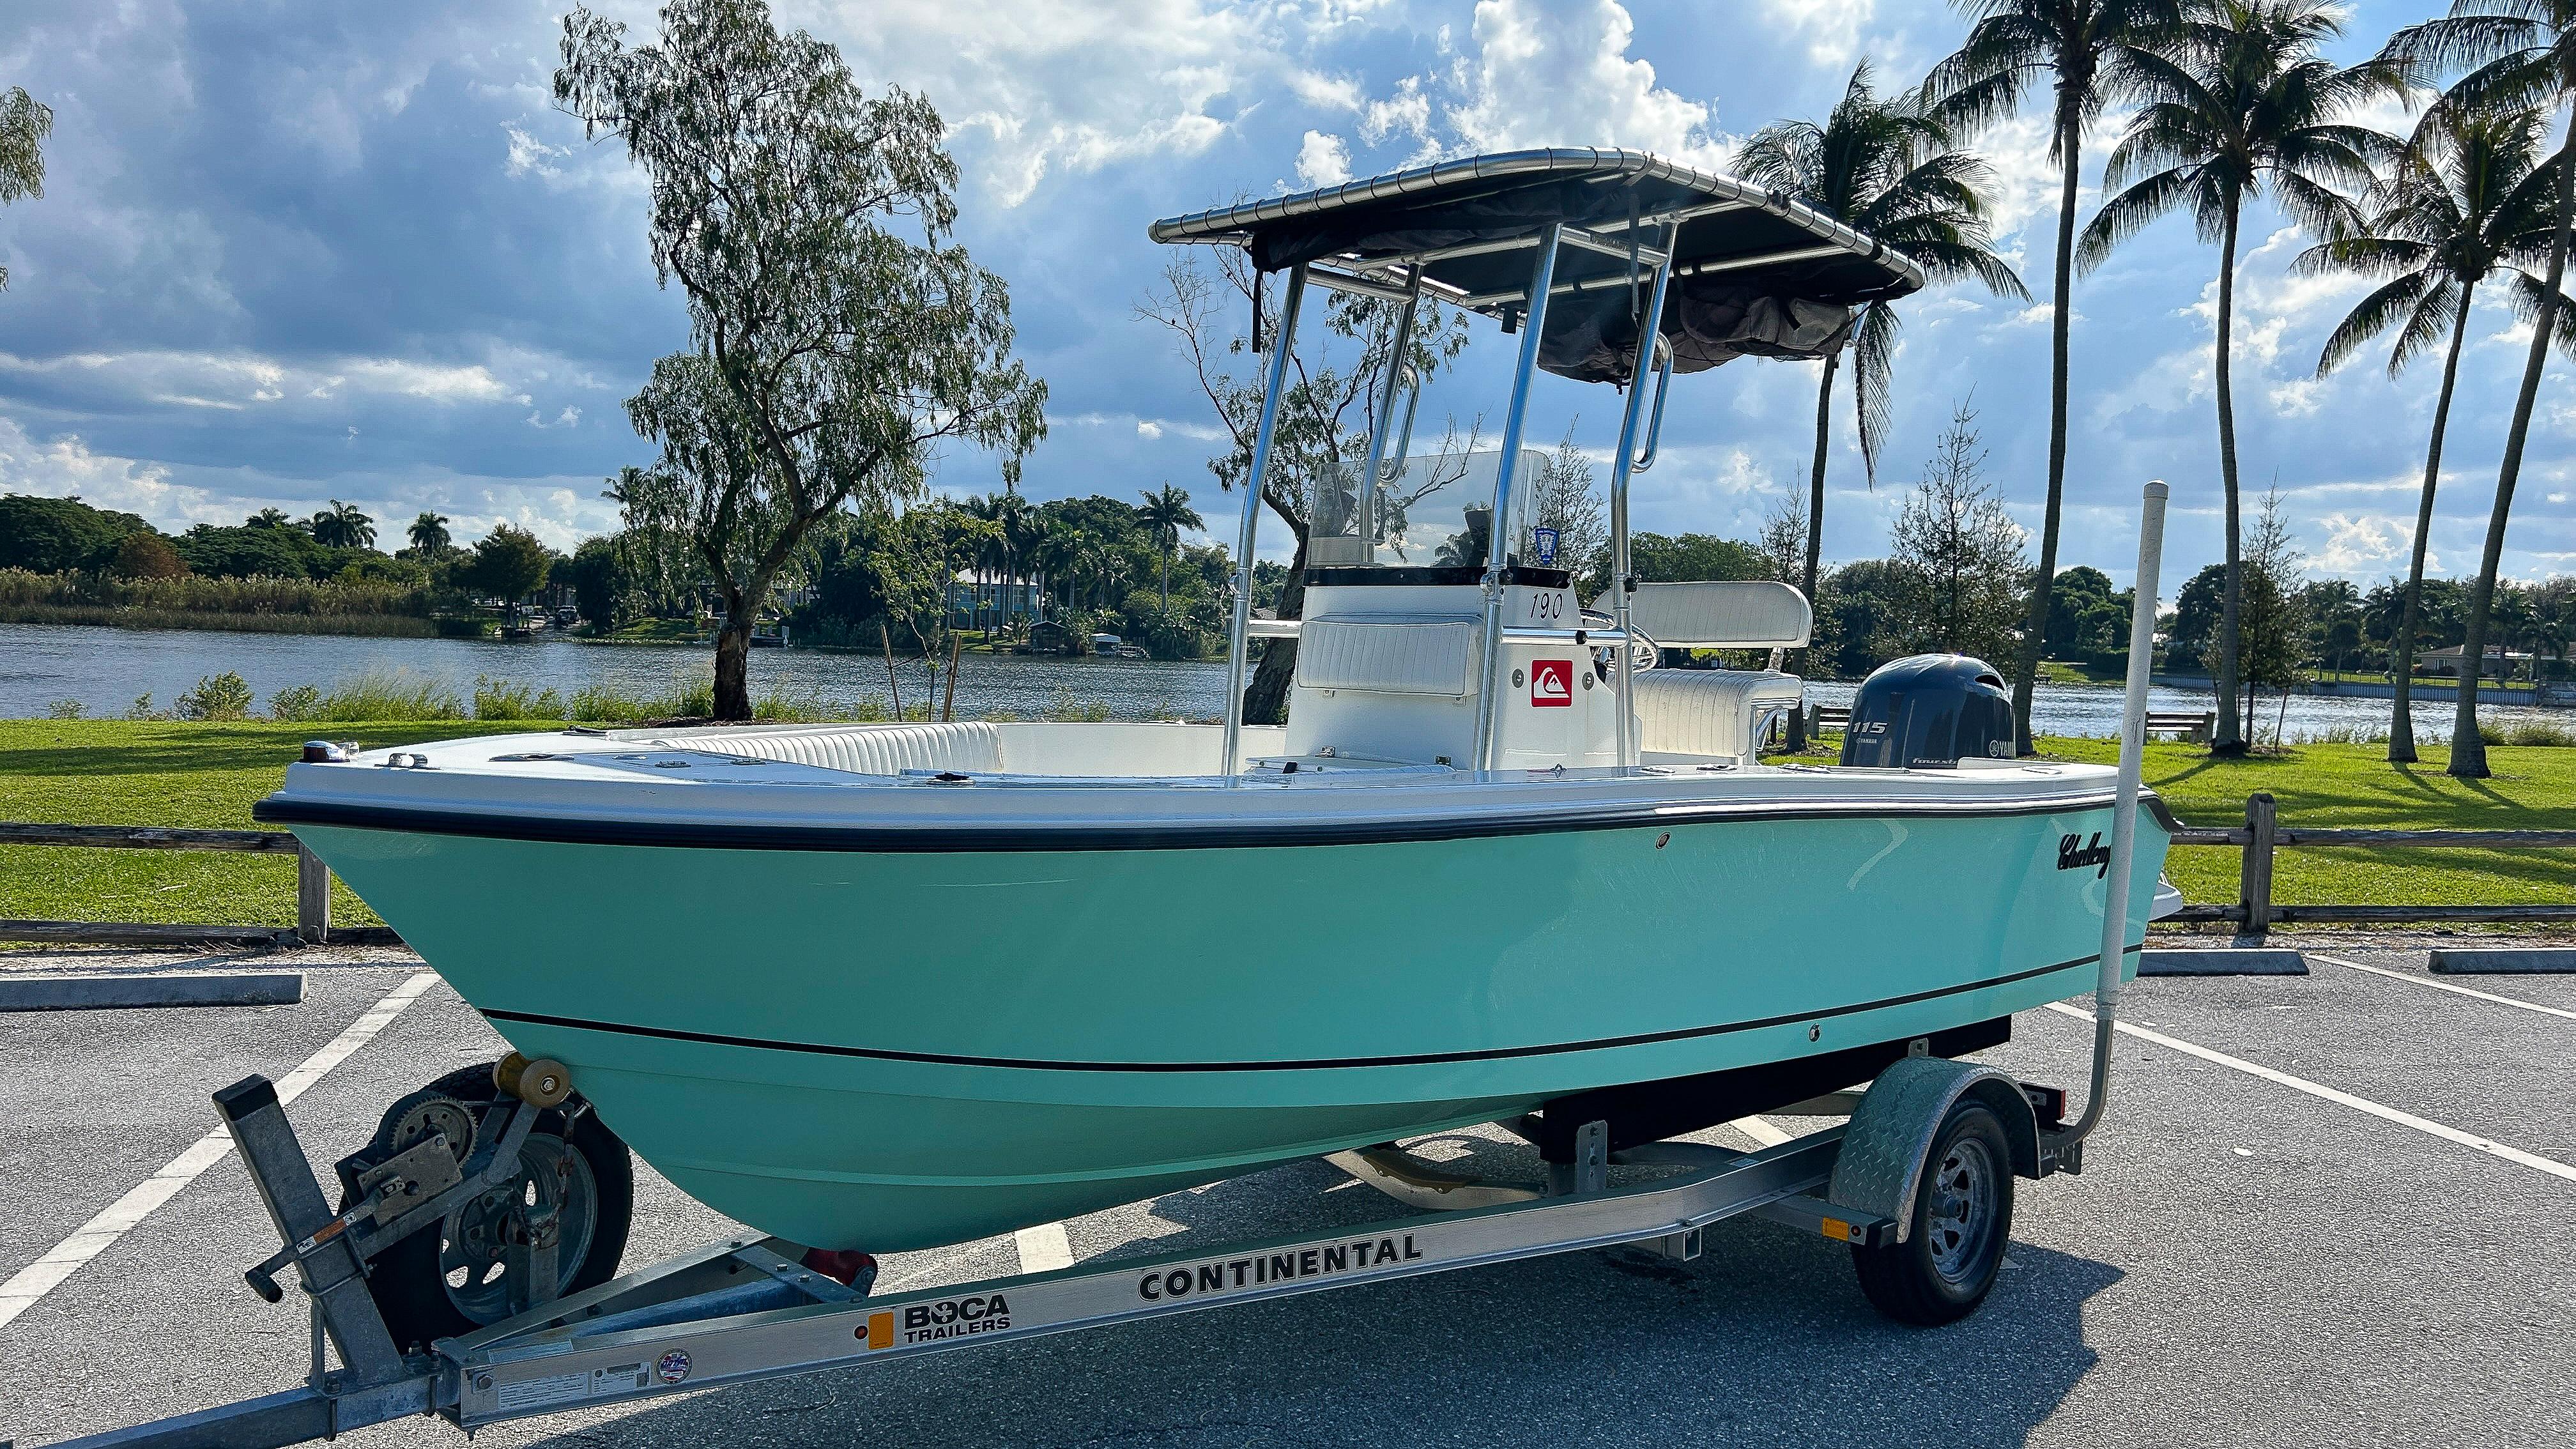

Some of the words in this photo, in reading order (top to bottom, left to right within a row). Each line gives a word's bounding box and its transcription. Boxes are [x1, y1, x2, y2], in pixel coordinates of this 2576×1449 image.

[1529, 592, 1563, 620] 190
[1853, 722, 1888, 733] 115
[2057, 831, 2112, 879] Challeng
[1137, 1233, 1423, 1301] CONTINENTAL
[904, 1294, 1011, 1330] BOCA
[903, 1317, 1011, 1344] TRAILERS
